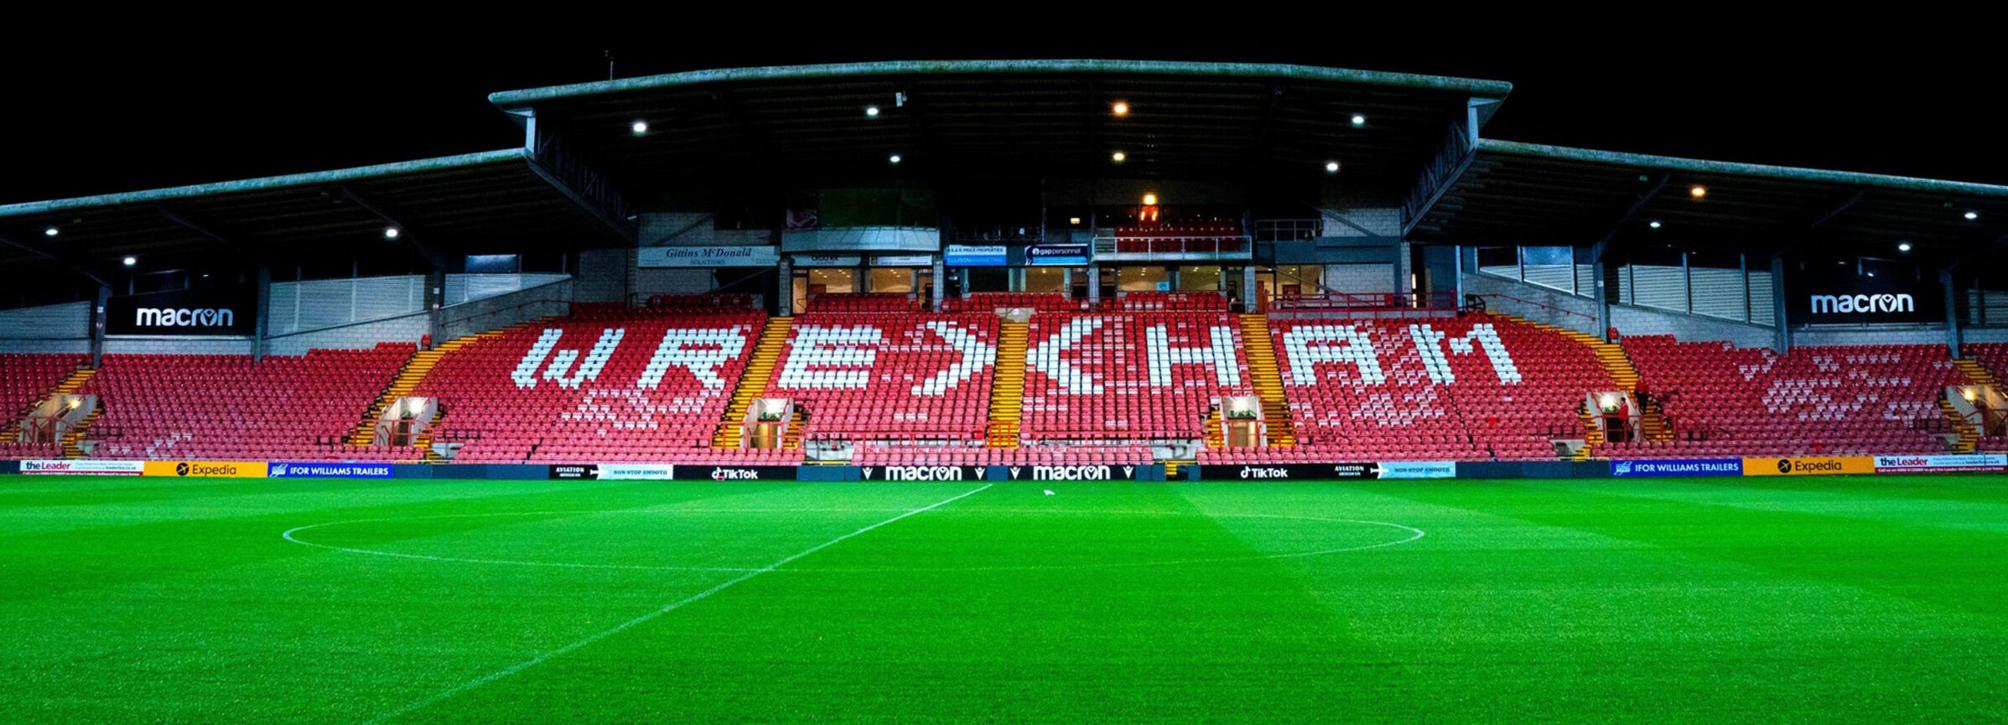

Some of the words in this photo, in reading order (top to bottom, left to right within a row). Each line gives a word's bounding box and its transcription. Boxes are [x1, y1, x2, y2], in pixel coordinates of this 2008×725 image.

[666, 248, 699, 258] Gittins
[1811, 294, 1914, 314] macron
[136, 308, 234, 327] macron
[41, 462, 71, 470] Leader
[1897, 456, 1928, 466] Leader
[192, 464, 237, 475] Expedia
[290, 467, 309, 475] IFOR
[311, 467, 351, 475] WILLIAMS
[352, 467, 389, 475] TRAILERS
[885, 466, 962, 480] macron
[1033, 465, 1111, 480] macron
[1251, 468, 1288, 478] TikTok
[1635, 464, 1656, 473] IFOR
[1658, 464, 1699, 472] WILLIAMS
[1701, 463, 1739, 472] TRAILERS
[1795, 460, 1842, 475] Expedia
[722, 469, 759, 480] TikTok
